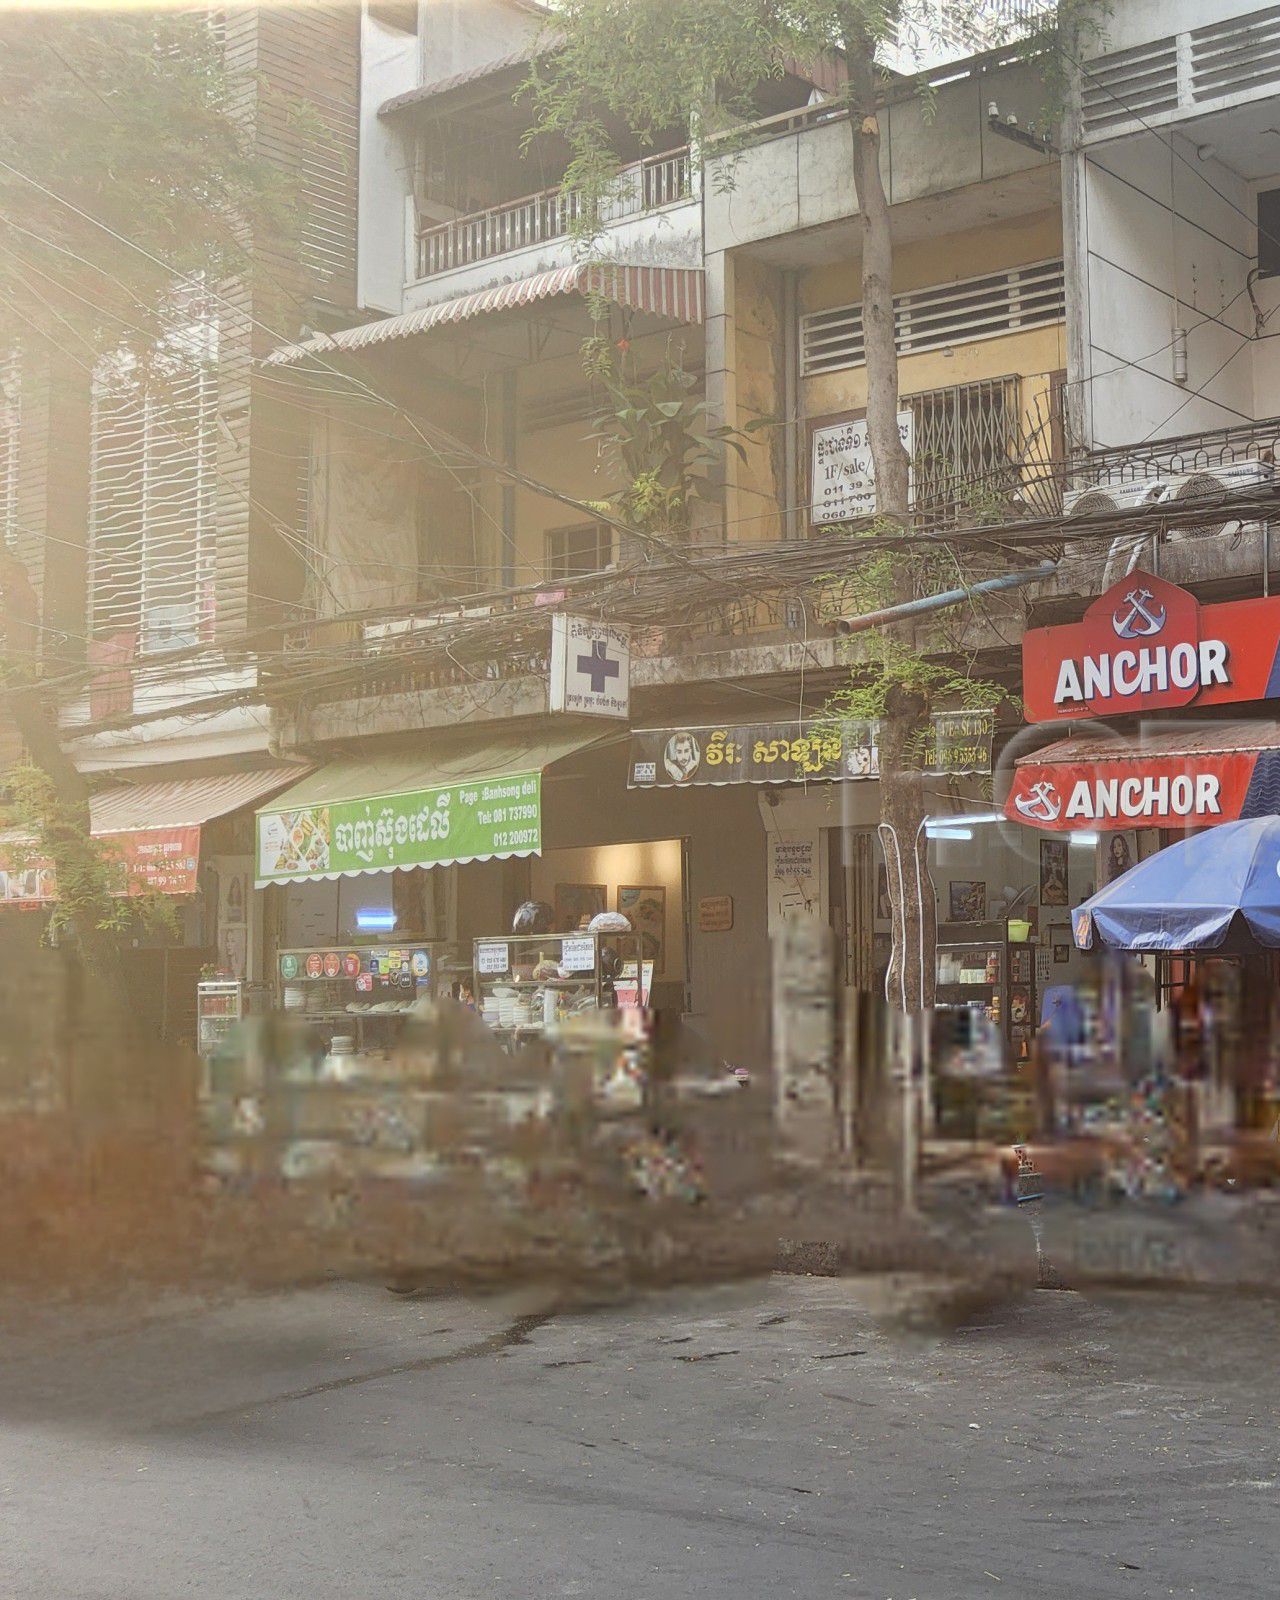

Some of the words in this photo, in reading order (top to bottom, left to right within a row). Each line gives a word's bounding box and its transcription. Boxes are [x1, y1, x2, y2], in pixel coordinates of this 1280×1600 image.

[1053, 640, 1229, 704] ANCHOR
[459, 789, 478, 806] Page
[521, 780, 537, 795] deli
[1064, 773, 1222, 820] ANCHOR
[493, 832, 508, 847] 012
